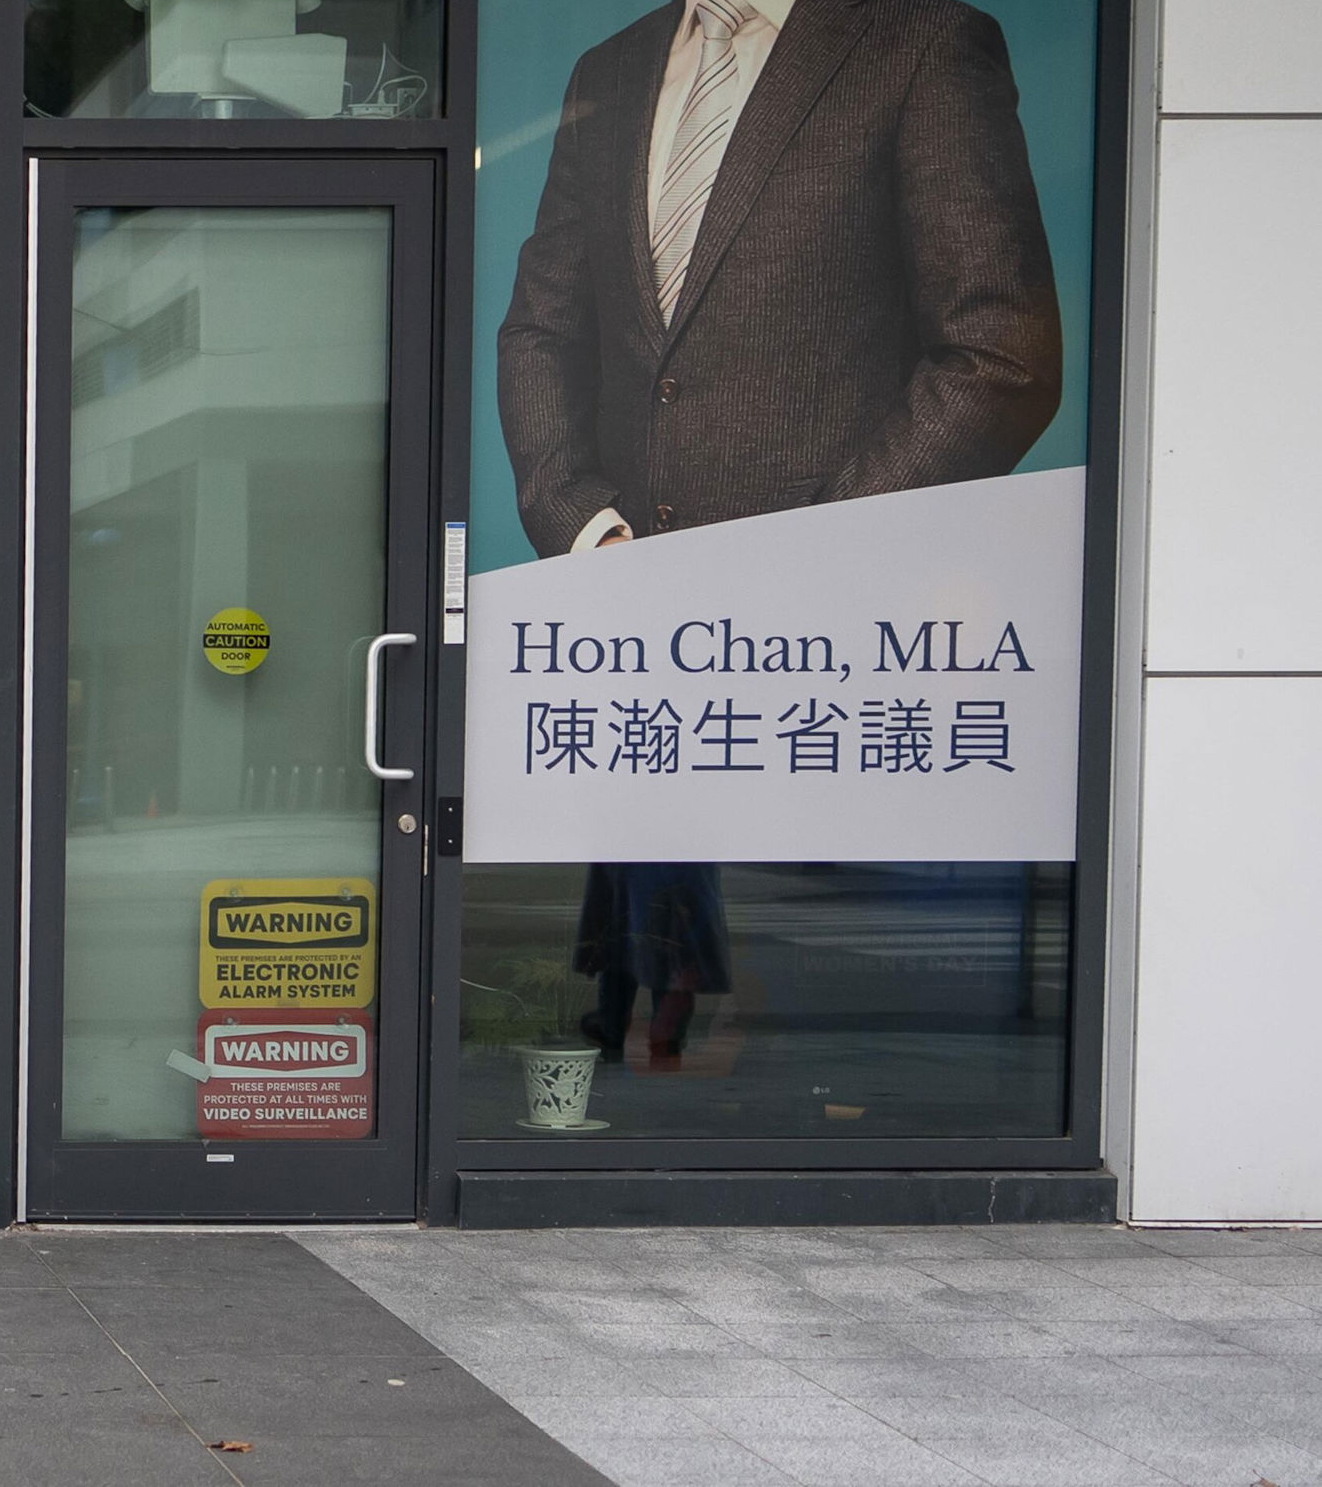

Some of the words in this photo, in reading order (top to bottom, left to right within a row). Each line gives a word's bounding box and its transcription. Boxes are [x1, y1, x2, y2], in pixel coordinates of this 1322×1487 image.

[207, 623, 265, 631] AUTOMATIC
[205, 636, 267, 648] CAUTION
[510, 622, 649, 673] Hon
[671, 618, 850, 682] Chan,
[873, 621, 1035, 672] MLA
[527, 698, 1015, 774] 陳瀚生省議員
[226, 912, 353, 932] WARNING
[215, 963, 360, 982] ELECTRONIC
[219, 985, 281, 998] ALARM
[288, 984, 355, 998] SYSTEM
[221, 1041, 349, 1061] WARNING
[230, 1083, 263, 1091] THESE
[267, 1081, 317, 1091] PREMISES
[321, 1082, 341, 1091] ARE
[204, 1095, 266, 1104] PROTECTED
[269, 1095, 283, 1103] AT
[285, 1095, 304, 1104] ALL
[307, 1095, 338, 1103] TIMES
[341, 1095, 366, 1103] WITH
[204, 1107, 250, 1119] VIDEO
[255, 1108, 367, 1119] SURVEILLANCE
